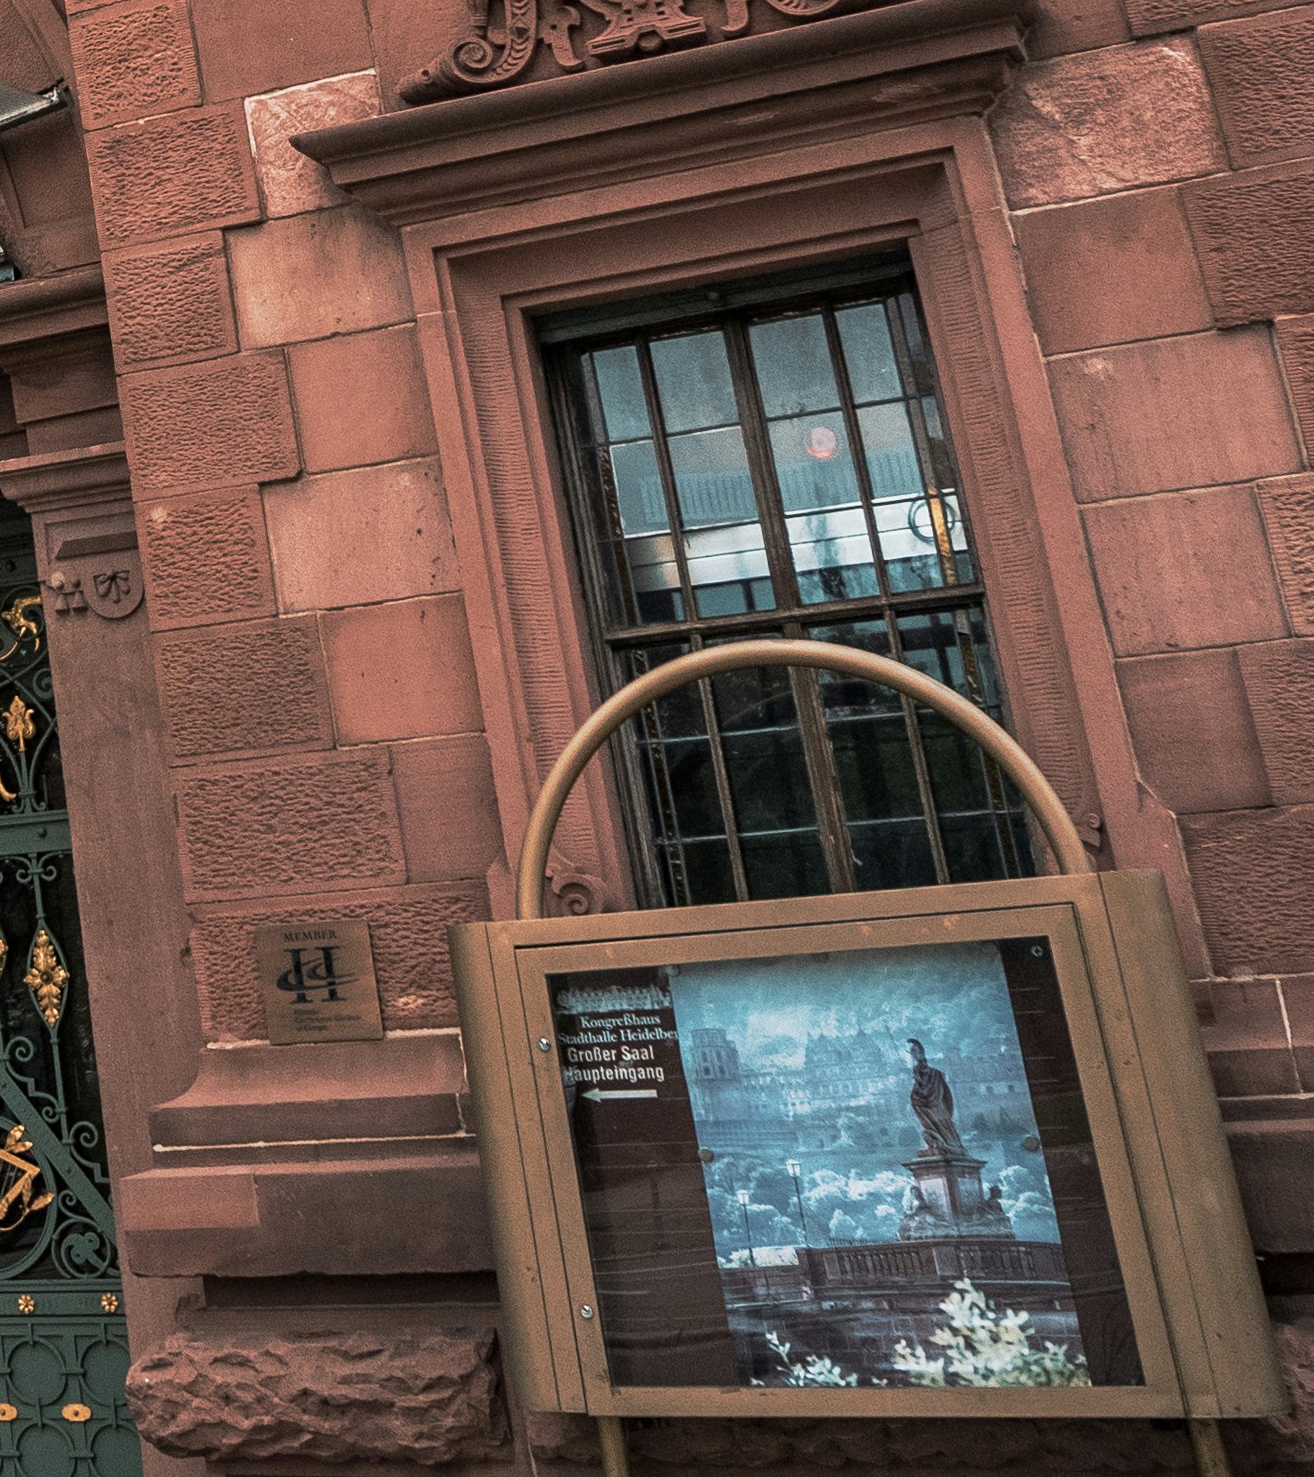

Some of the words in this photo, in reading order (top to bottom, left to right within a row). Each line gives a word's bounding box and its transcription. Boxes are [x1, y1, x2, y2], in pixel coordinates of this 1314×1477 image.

[284, 929, 338, 943] MEMBER
[580, 1012, 661, 1030] Kongreßhaus
[557, 1030, 618, 1045] Stadthalle
[567, 1046, 617, 1063] Großer
[621, 1045, 655, 1061] Saal
[563, 1065, 665, 1084] Haupteingang
